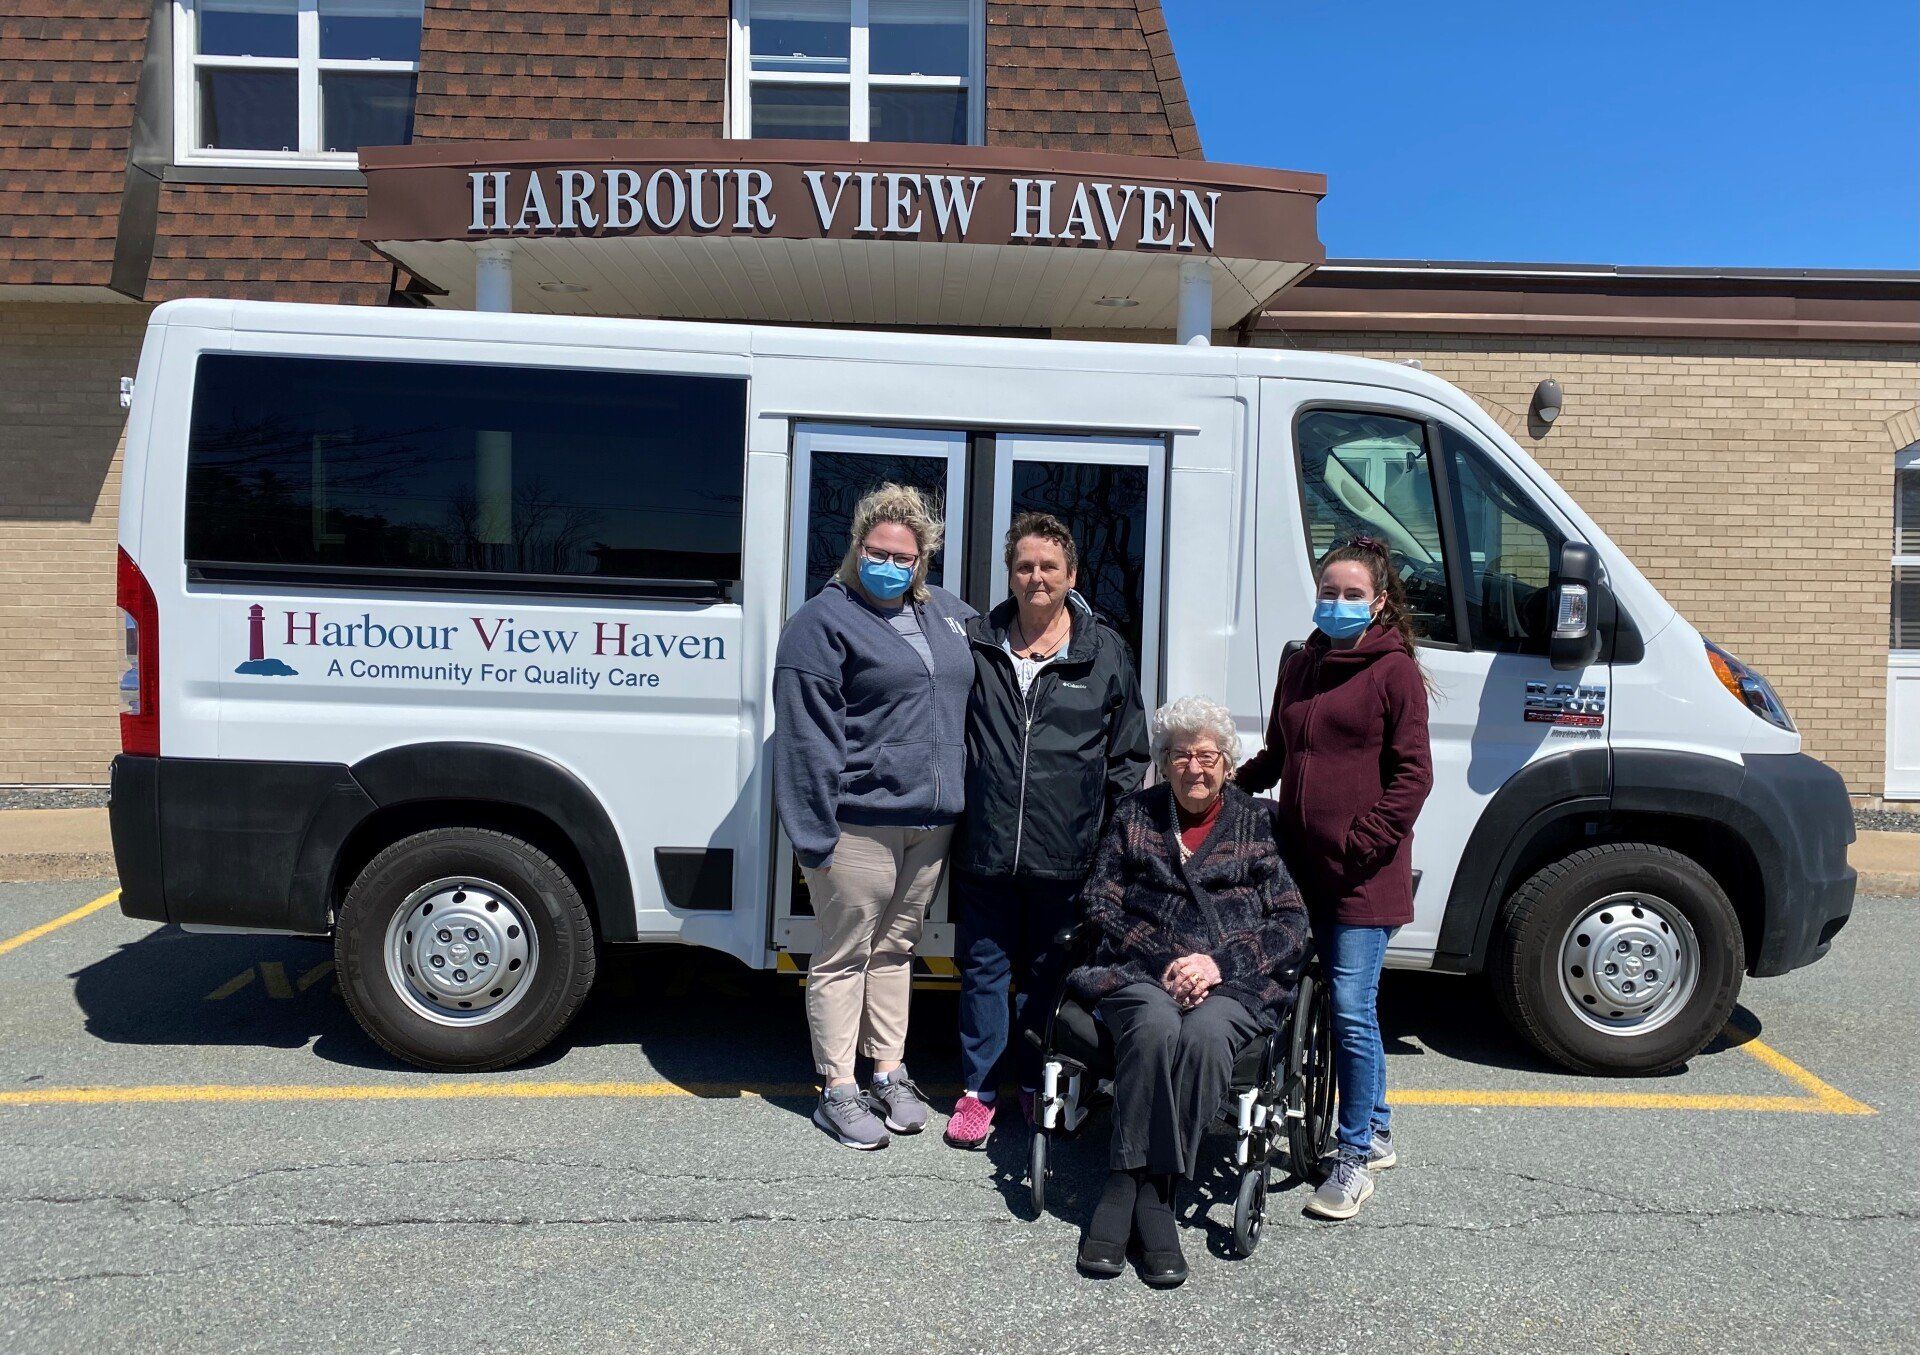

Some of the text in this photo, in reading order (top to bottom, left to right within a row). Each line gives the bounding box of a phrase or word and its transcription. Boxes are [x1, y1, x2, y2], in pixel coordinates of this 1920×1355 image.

[467, 168, 1222, 249] HARBOUR VIEW HAVEN
[282, 611, 727, 660] Harbour View Haven
[327, 659, 660, 689] A Community For Quality Care
[1525, 696, 1606, 713] 2500
[1526, 682, 1606, 699] RAM
